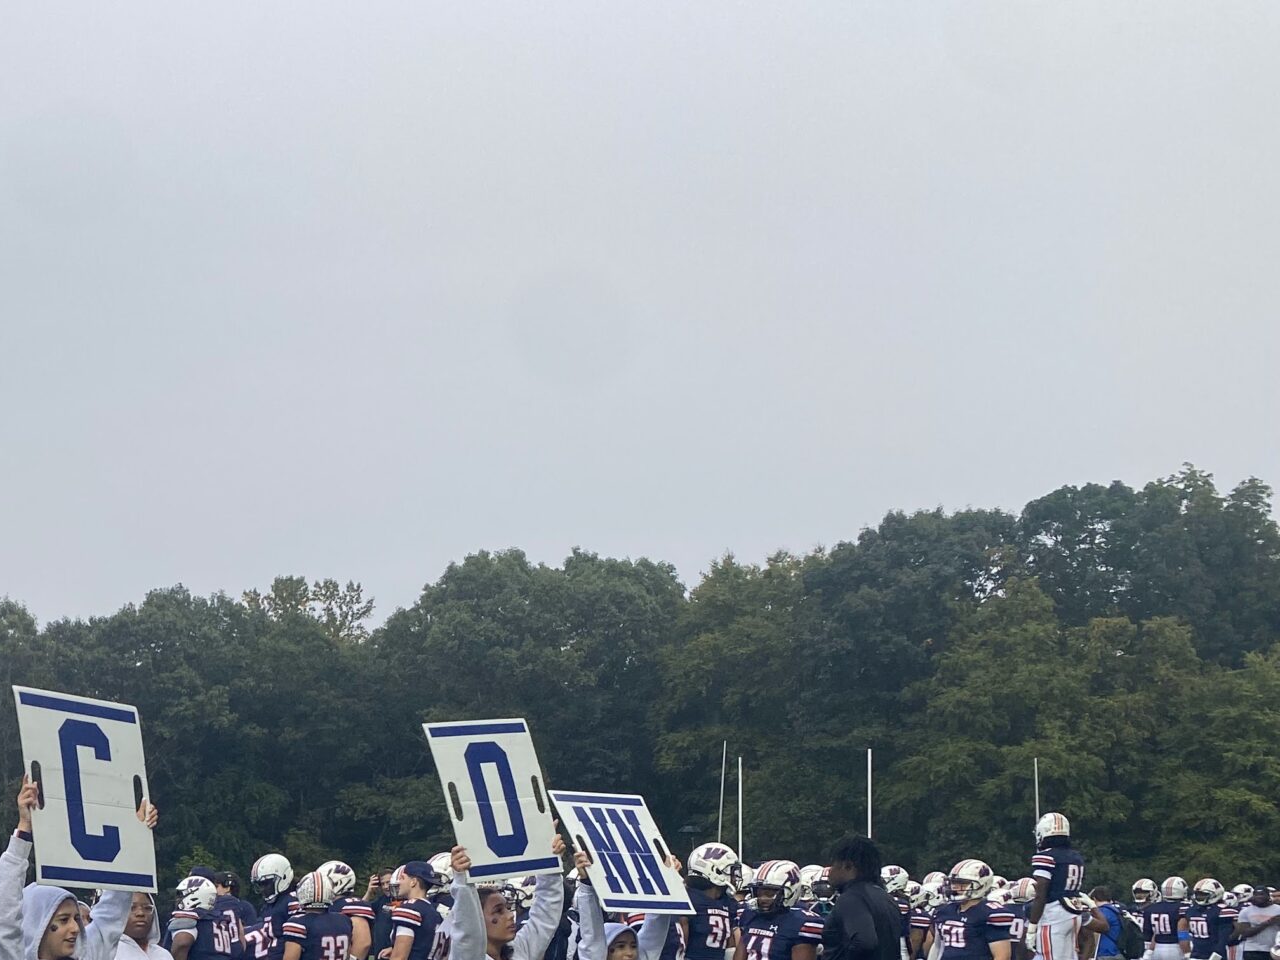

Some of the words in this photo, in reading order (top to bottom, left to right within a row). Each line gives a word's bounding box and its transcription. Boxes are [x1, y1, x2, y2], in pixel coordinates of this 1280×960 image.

[58, 718, 121, 863] C
[464, 741, 529, 858] O
[572, 806, 671, 896] NN
[703, 847, 727, 860] W
